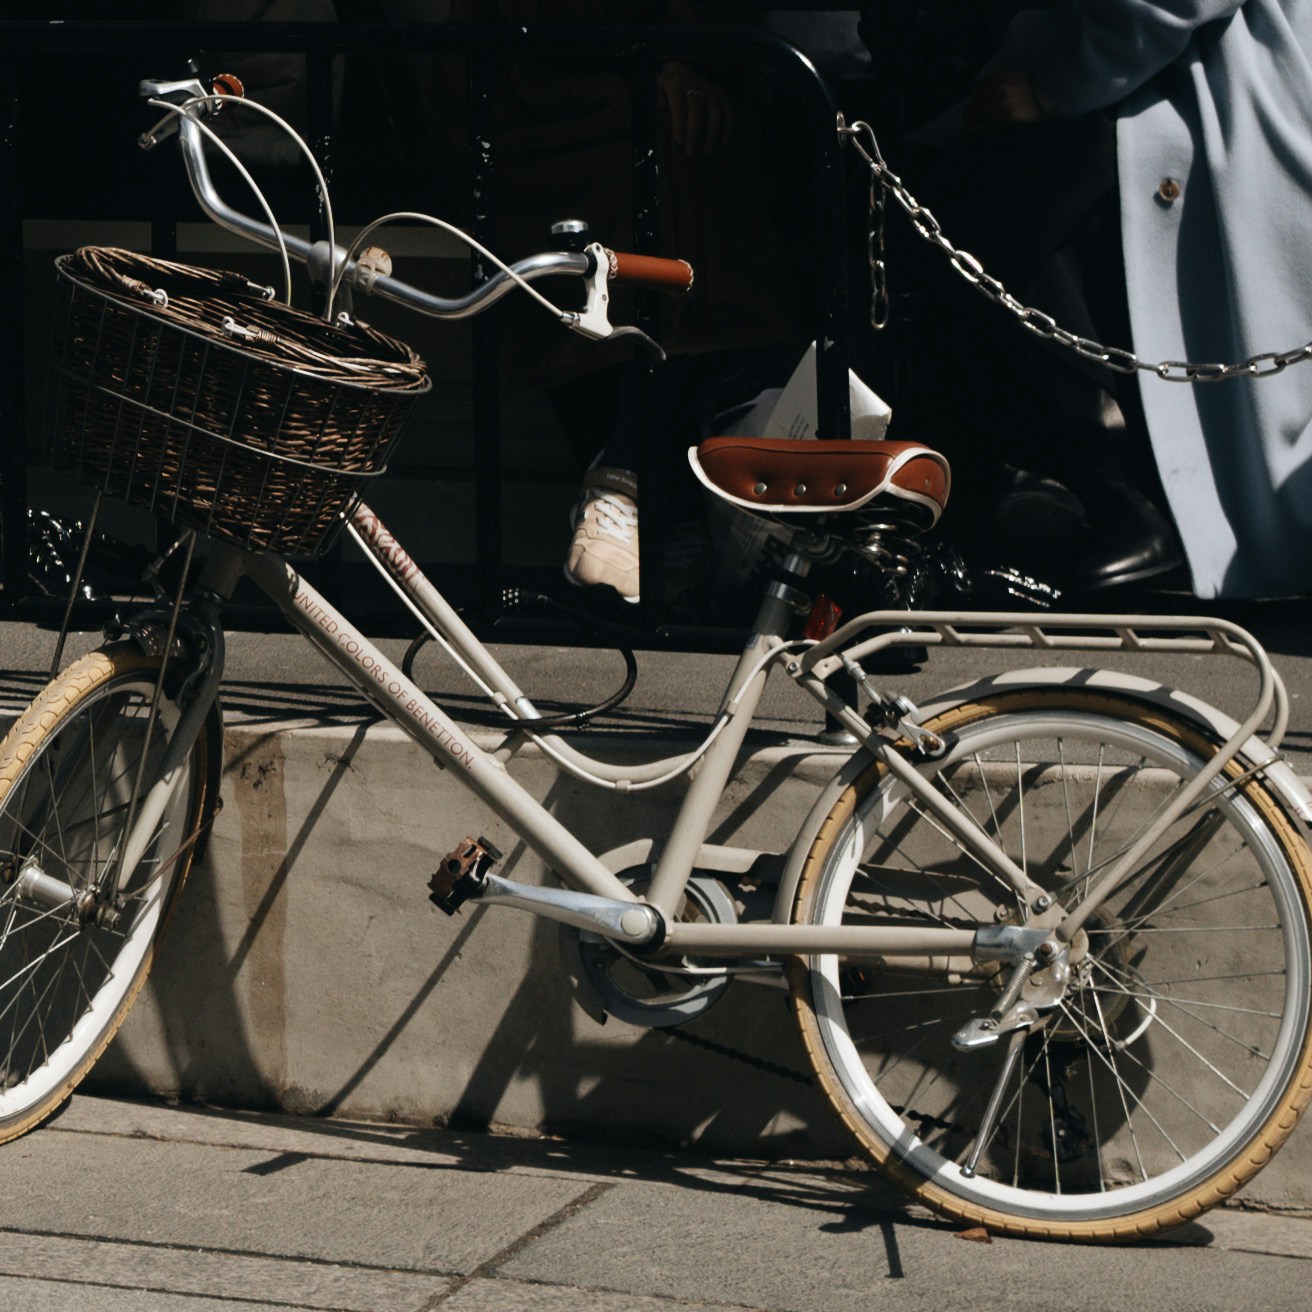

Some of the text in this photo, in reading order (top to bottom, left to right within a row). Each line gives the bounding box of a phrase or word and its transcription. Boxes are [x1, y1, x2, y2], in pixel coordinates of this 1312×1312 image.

[294, 591, 476, 770] UNITED COLORS OF BENETTON.
